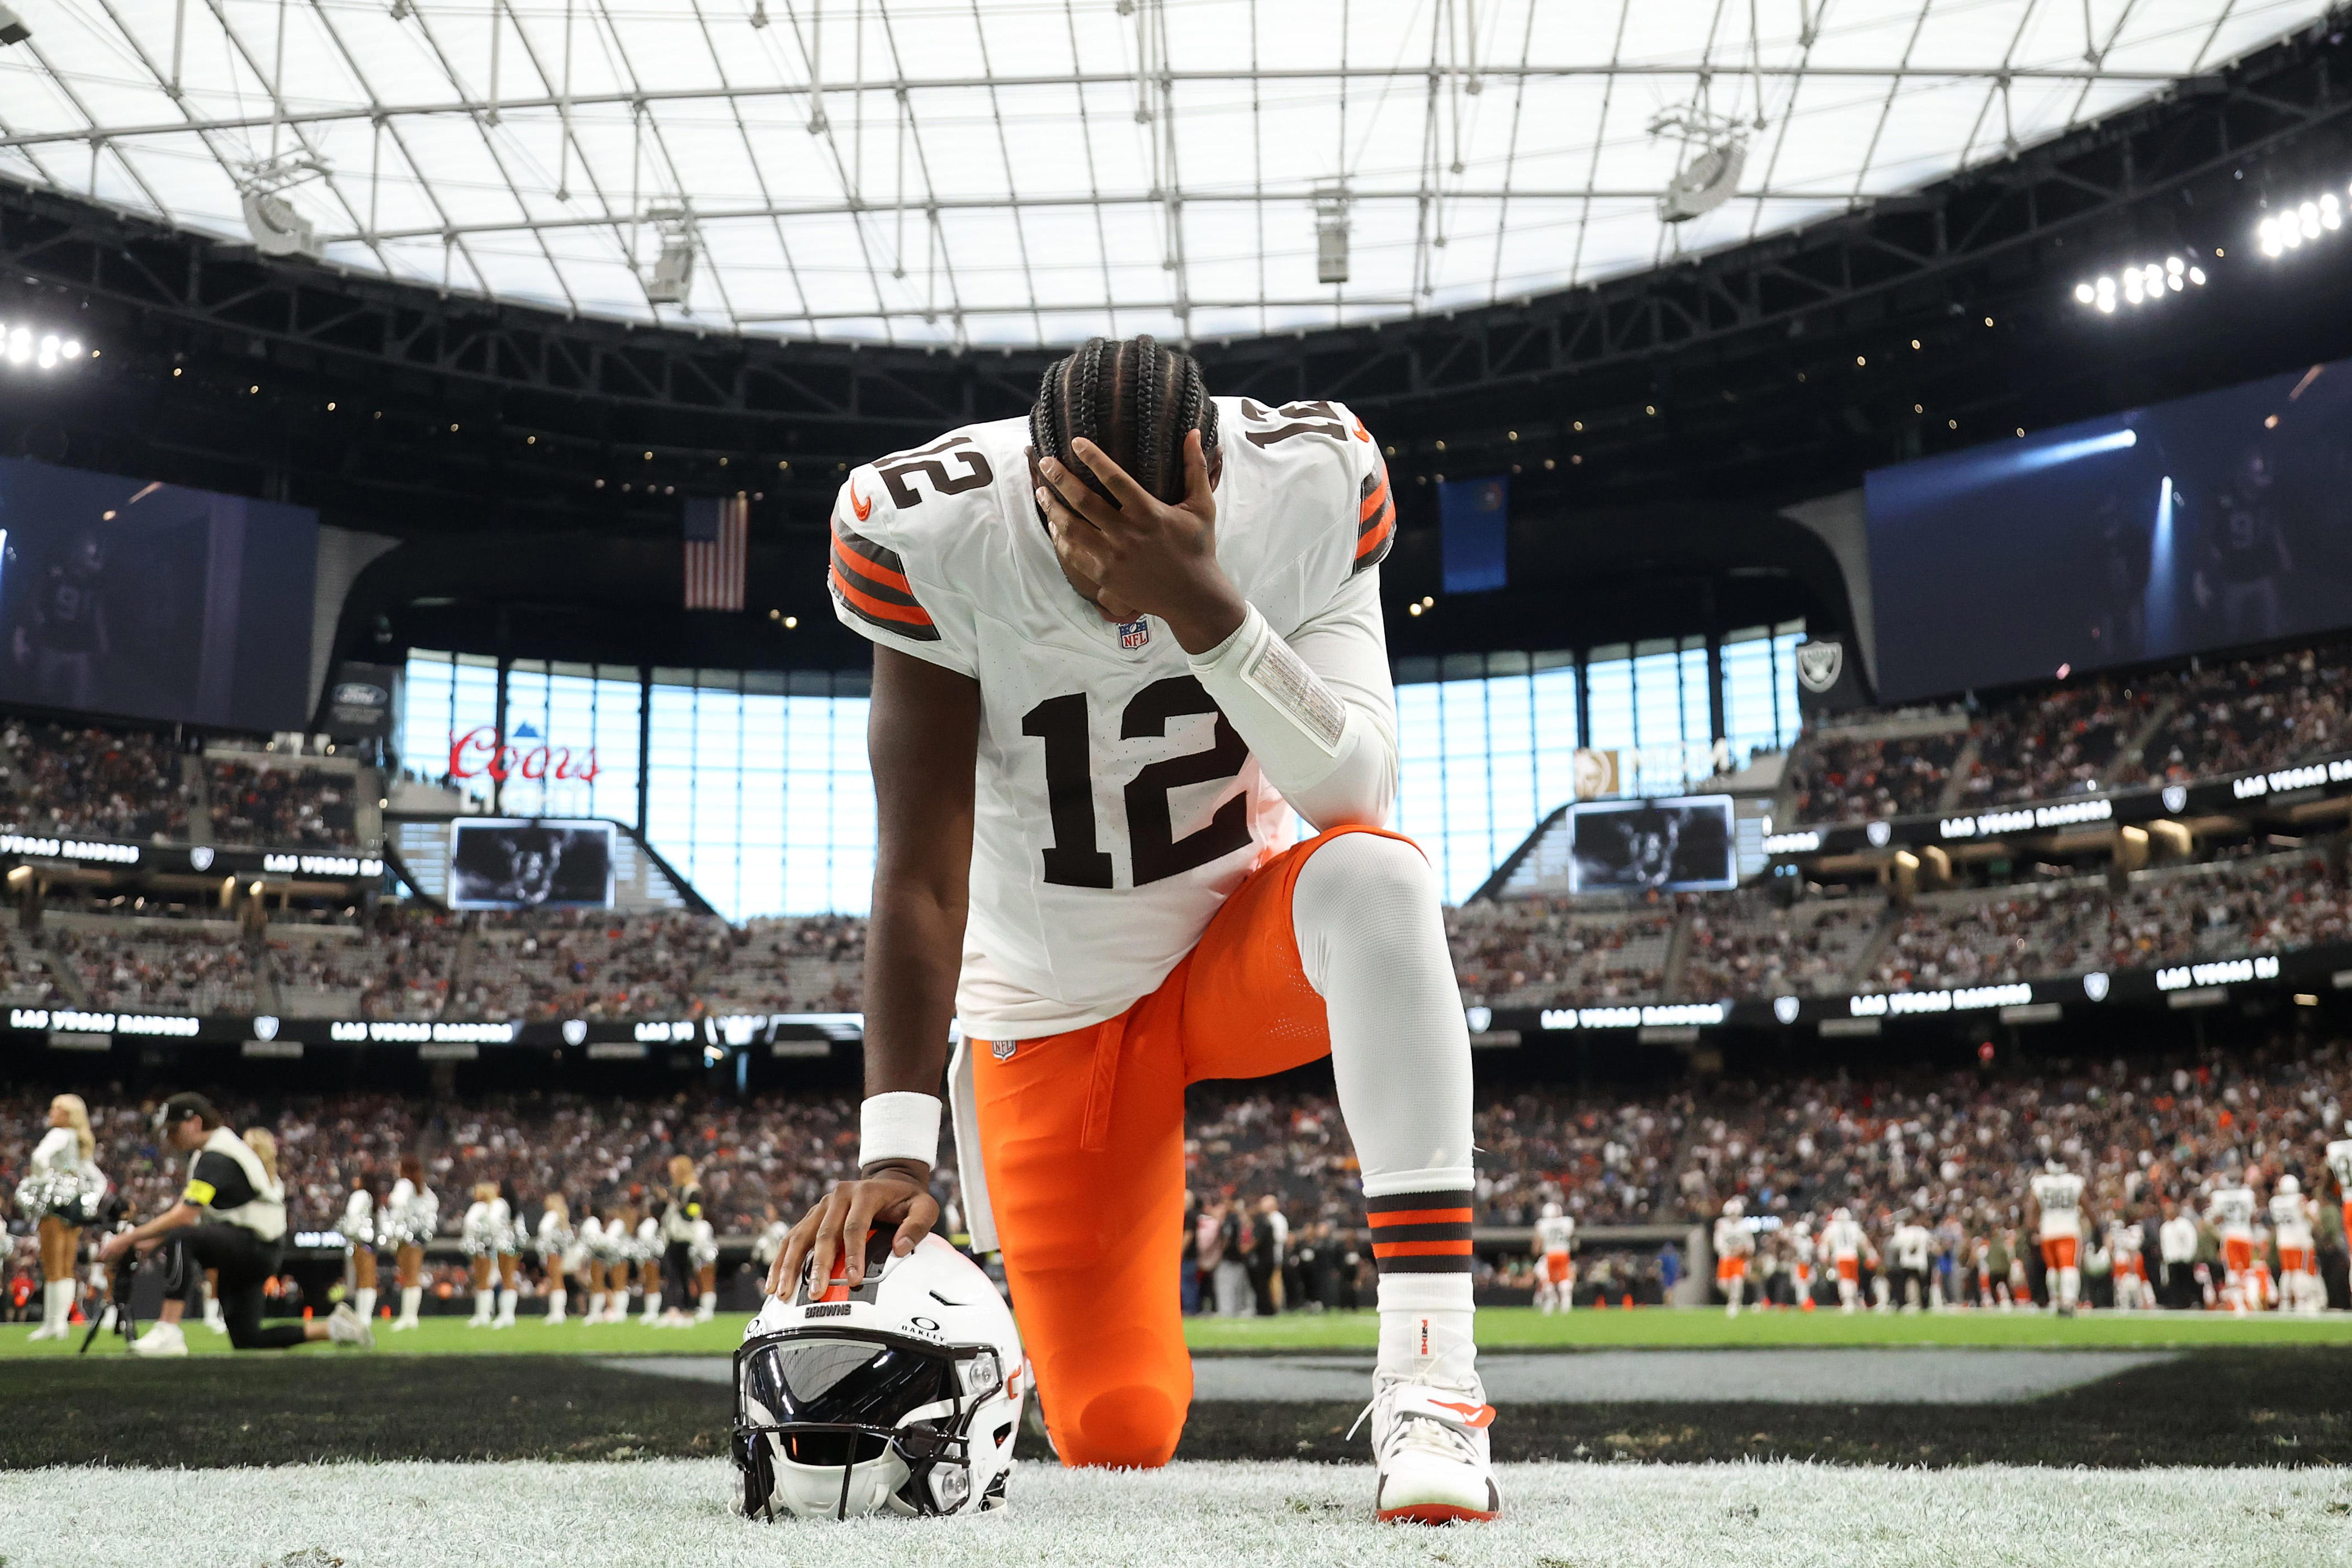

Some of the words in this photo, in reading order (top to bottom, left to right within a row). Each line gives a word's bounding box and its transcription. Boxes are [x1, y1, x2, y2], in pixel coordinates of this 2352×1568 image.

[871, 437, 994, 509] 12
[1123, 632, 1146, 647] NFL
[449, 726, 601, 781] Coors
[1021, 674, 1254, 889] 12
[995, 1040, 1012, 1053] NFL
[805, 1304, 851, 1319] BROWNS
[902, 1325, 945, 1342] OAKLEY
